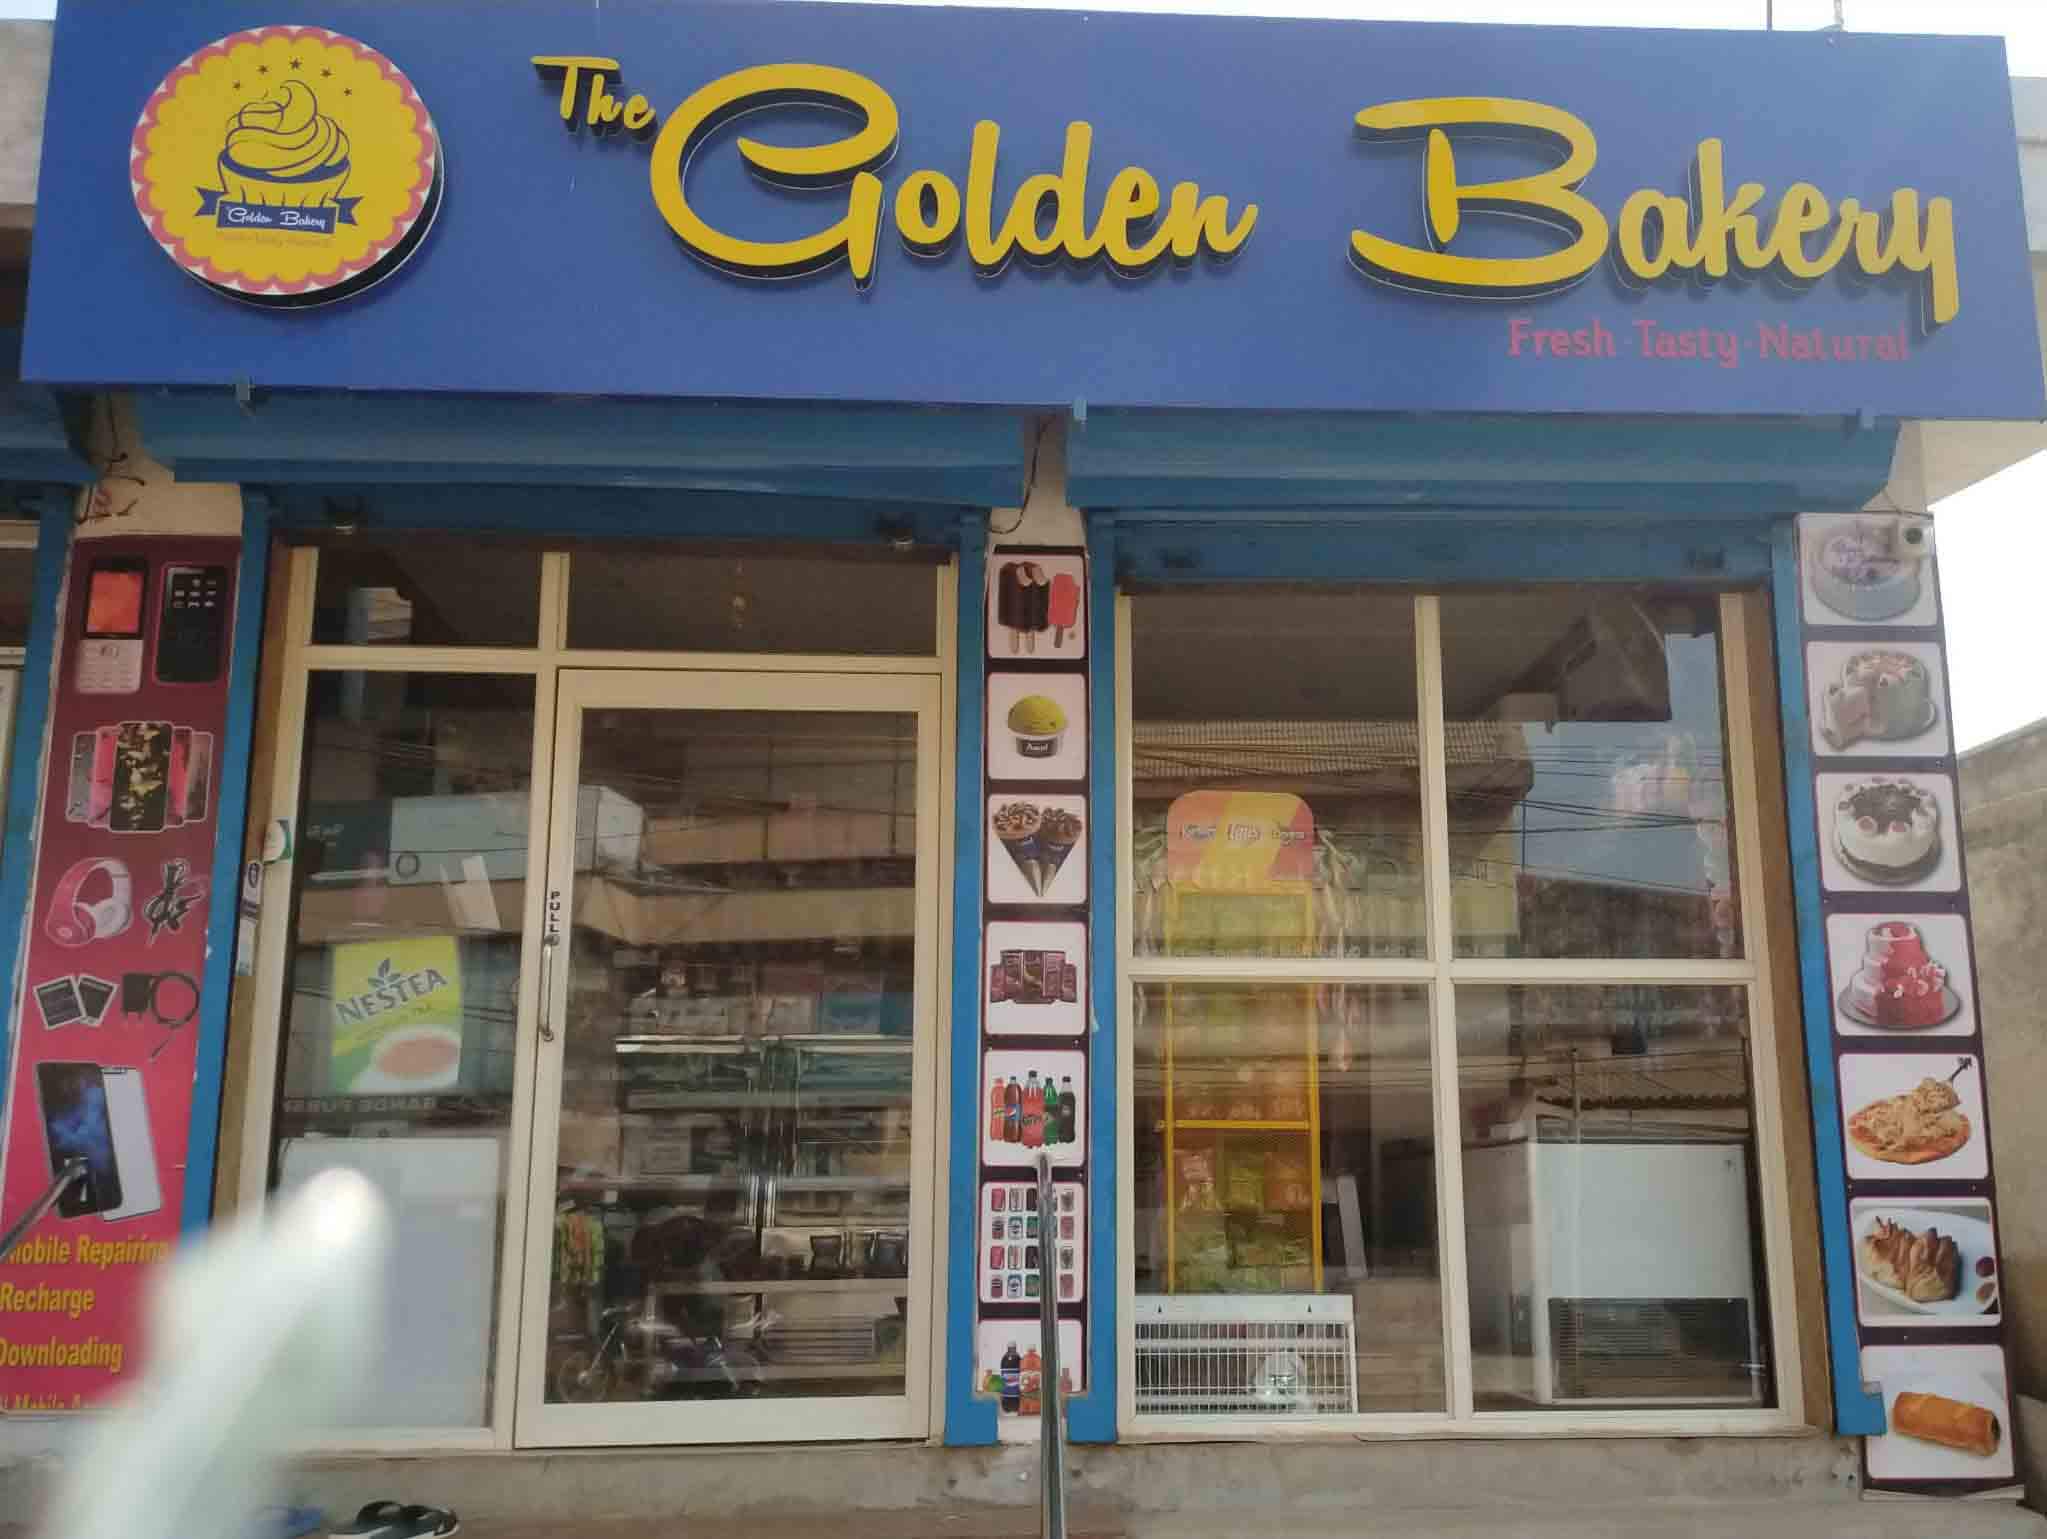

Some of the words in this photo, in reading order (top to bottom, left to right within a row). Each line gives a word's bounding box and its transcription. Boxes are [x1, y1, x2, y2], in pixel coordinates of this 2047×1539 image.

[530, 55, 655, 131] The
[650, 63, 1259, 280] Golden
[1350, 96, 1960, 325] Bakery
[228, 207, 273, 223] Golden
[280, 210, 326, 230] Bakery
[1507, 318, 1617, 358] Fresh
[1632, 318, 1740, 369] Tasty
[1758, 321, 1910, 362] Natural
[550, 890, 561, 933] PULL
[335, 968, 447, 1025] NESTEA
[0, 1281, 96, 1320] Recharge
